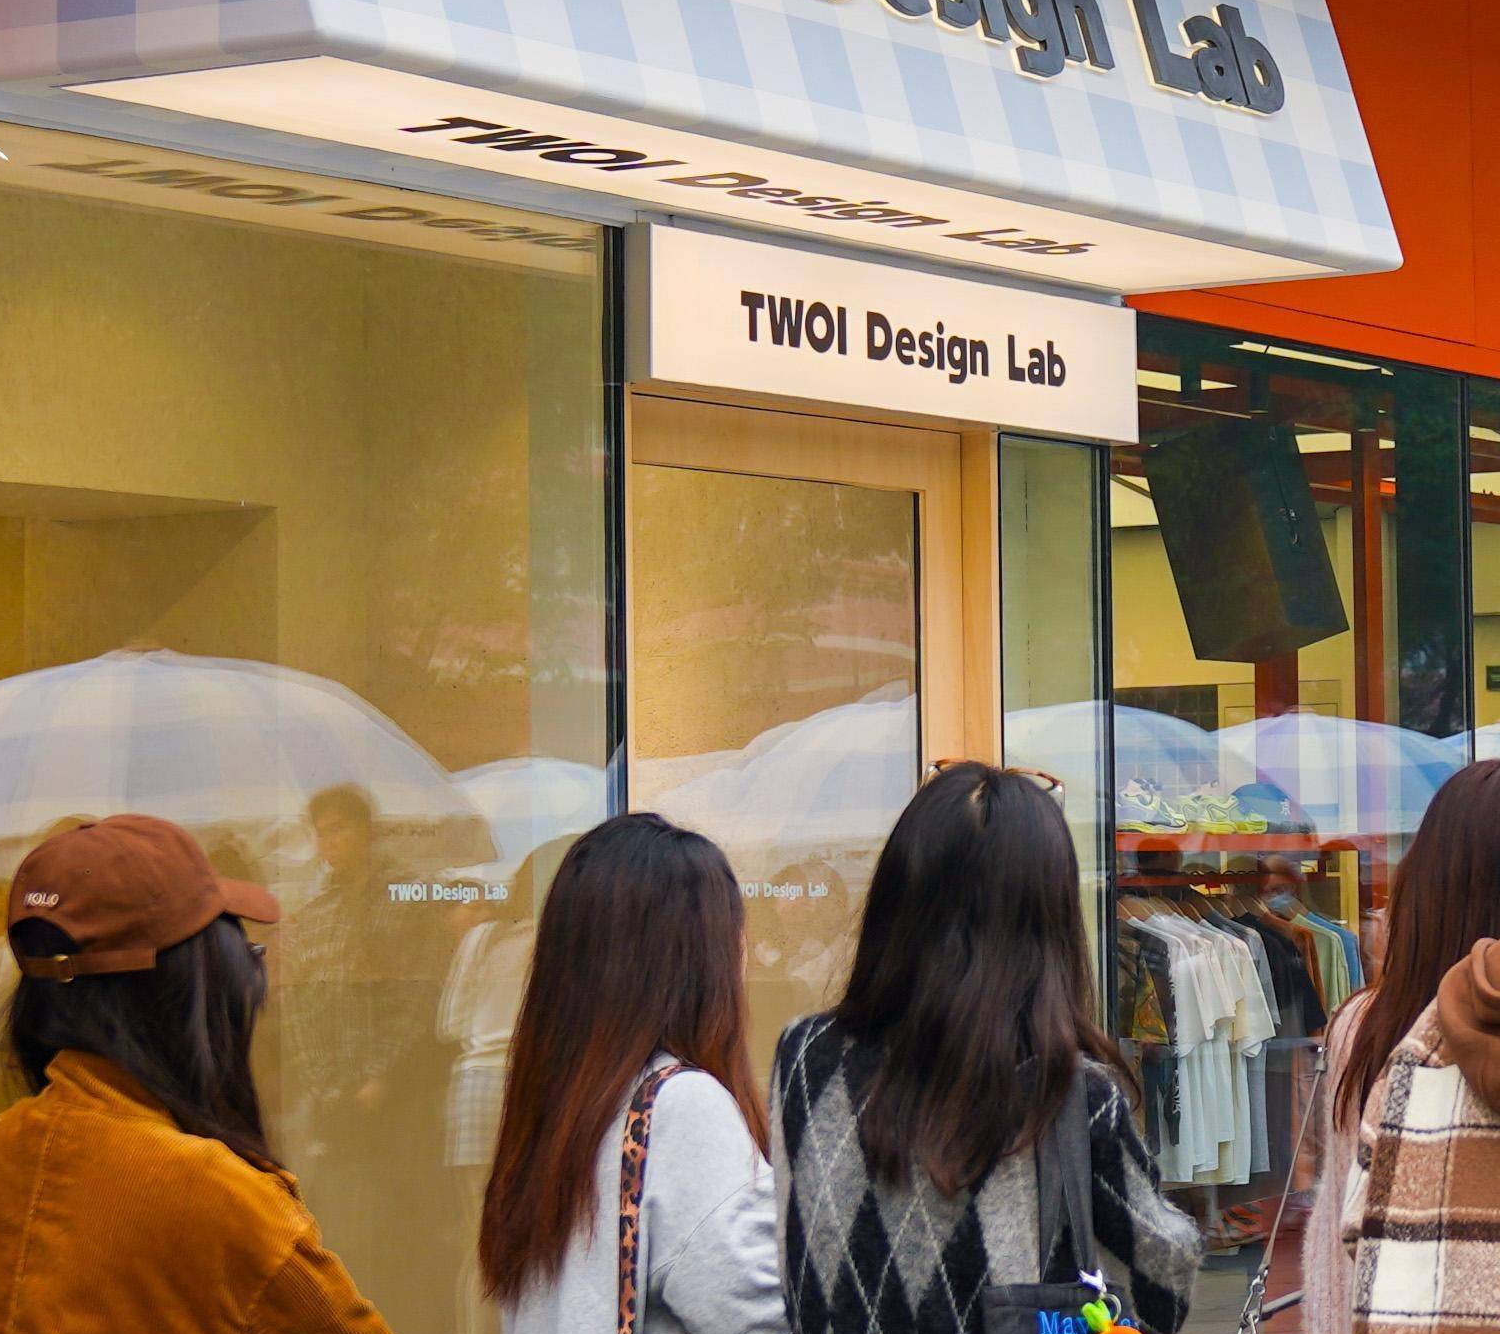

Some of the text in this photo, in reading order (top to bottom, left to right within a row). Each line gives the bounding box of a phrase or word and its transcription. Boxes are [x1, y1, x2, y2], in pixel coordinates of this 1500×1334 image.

[397, 116, 1099, 256] TWOI Design Lab
[740, 290, 1066, 387] TWOI Design Lab
[388, 883, 509, 904] TWOI Design Lab
[763, 882, 803, 900] Design
[808, 882, 829, 898] Lab
